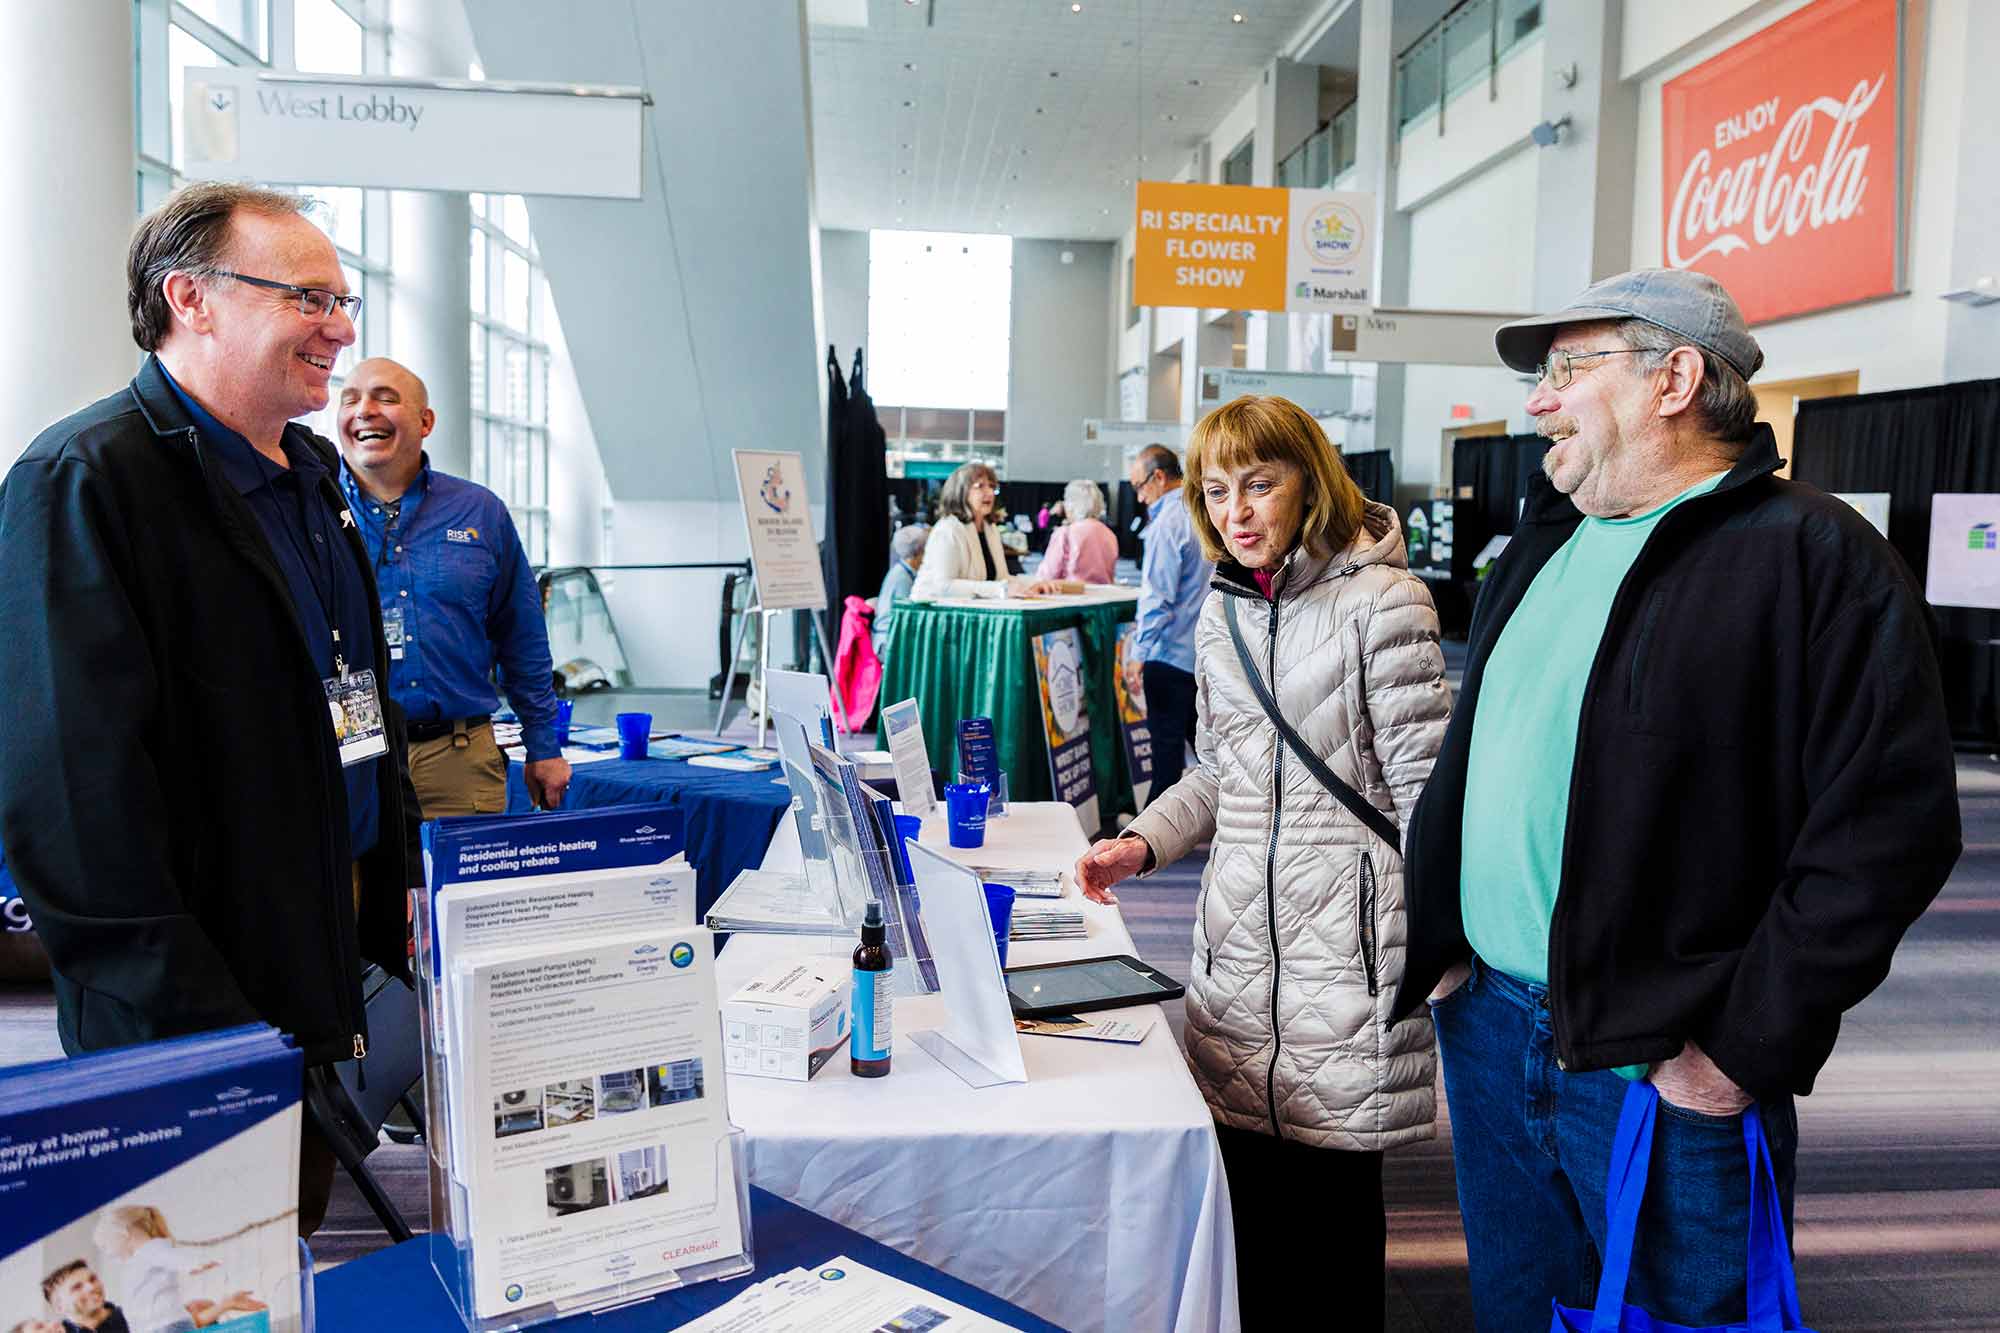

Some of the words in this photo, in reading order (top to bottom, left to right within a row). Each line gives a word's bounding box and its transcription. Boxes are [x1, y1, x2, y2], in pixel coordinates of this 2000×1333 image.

[257, 90, 327, 119] West
[339, 94, 424, 131] Lobby
[1714, 97, 1780, 149] ENJOY
[1667, 71, 1886, 269] Coca-Cola
[1141, 210, 1162, 229] RI
[1168, 211, 1283, 236] SPECIALTY
[1166, 239, 1256, 262] FLOWER
[1316, 240, 1351, 250] SHOW
[1176, 267, 1245, 288] SHOW
[1313, 287, 1368, 300] Marshall
[1366, 317, 1397, 333] Men
[447, 529, 470, 540] RISE
[460, 846, 518, 863] Residential
[519, 843, 556, 857] electric
[559, 840, 597, 853] heating
[459, 862, 480, 875] and
[481, 859, 520, 873] cooling
[522, 856, 560, 868] rebates
[26, 1144, 86, 1168] natural
[90, 1139, 119, 1157] gas
[123, 1125, 183, 1148] rebates
[42, 1136, 58, 1150] at
[61, 1127, 110, 1146] home
[662, 1239, 719, 1262] CLEAResult
